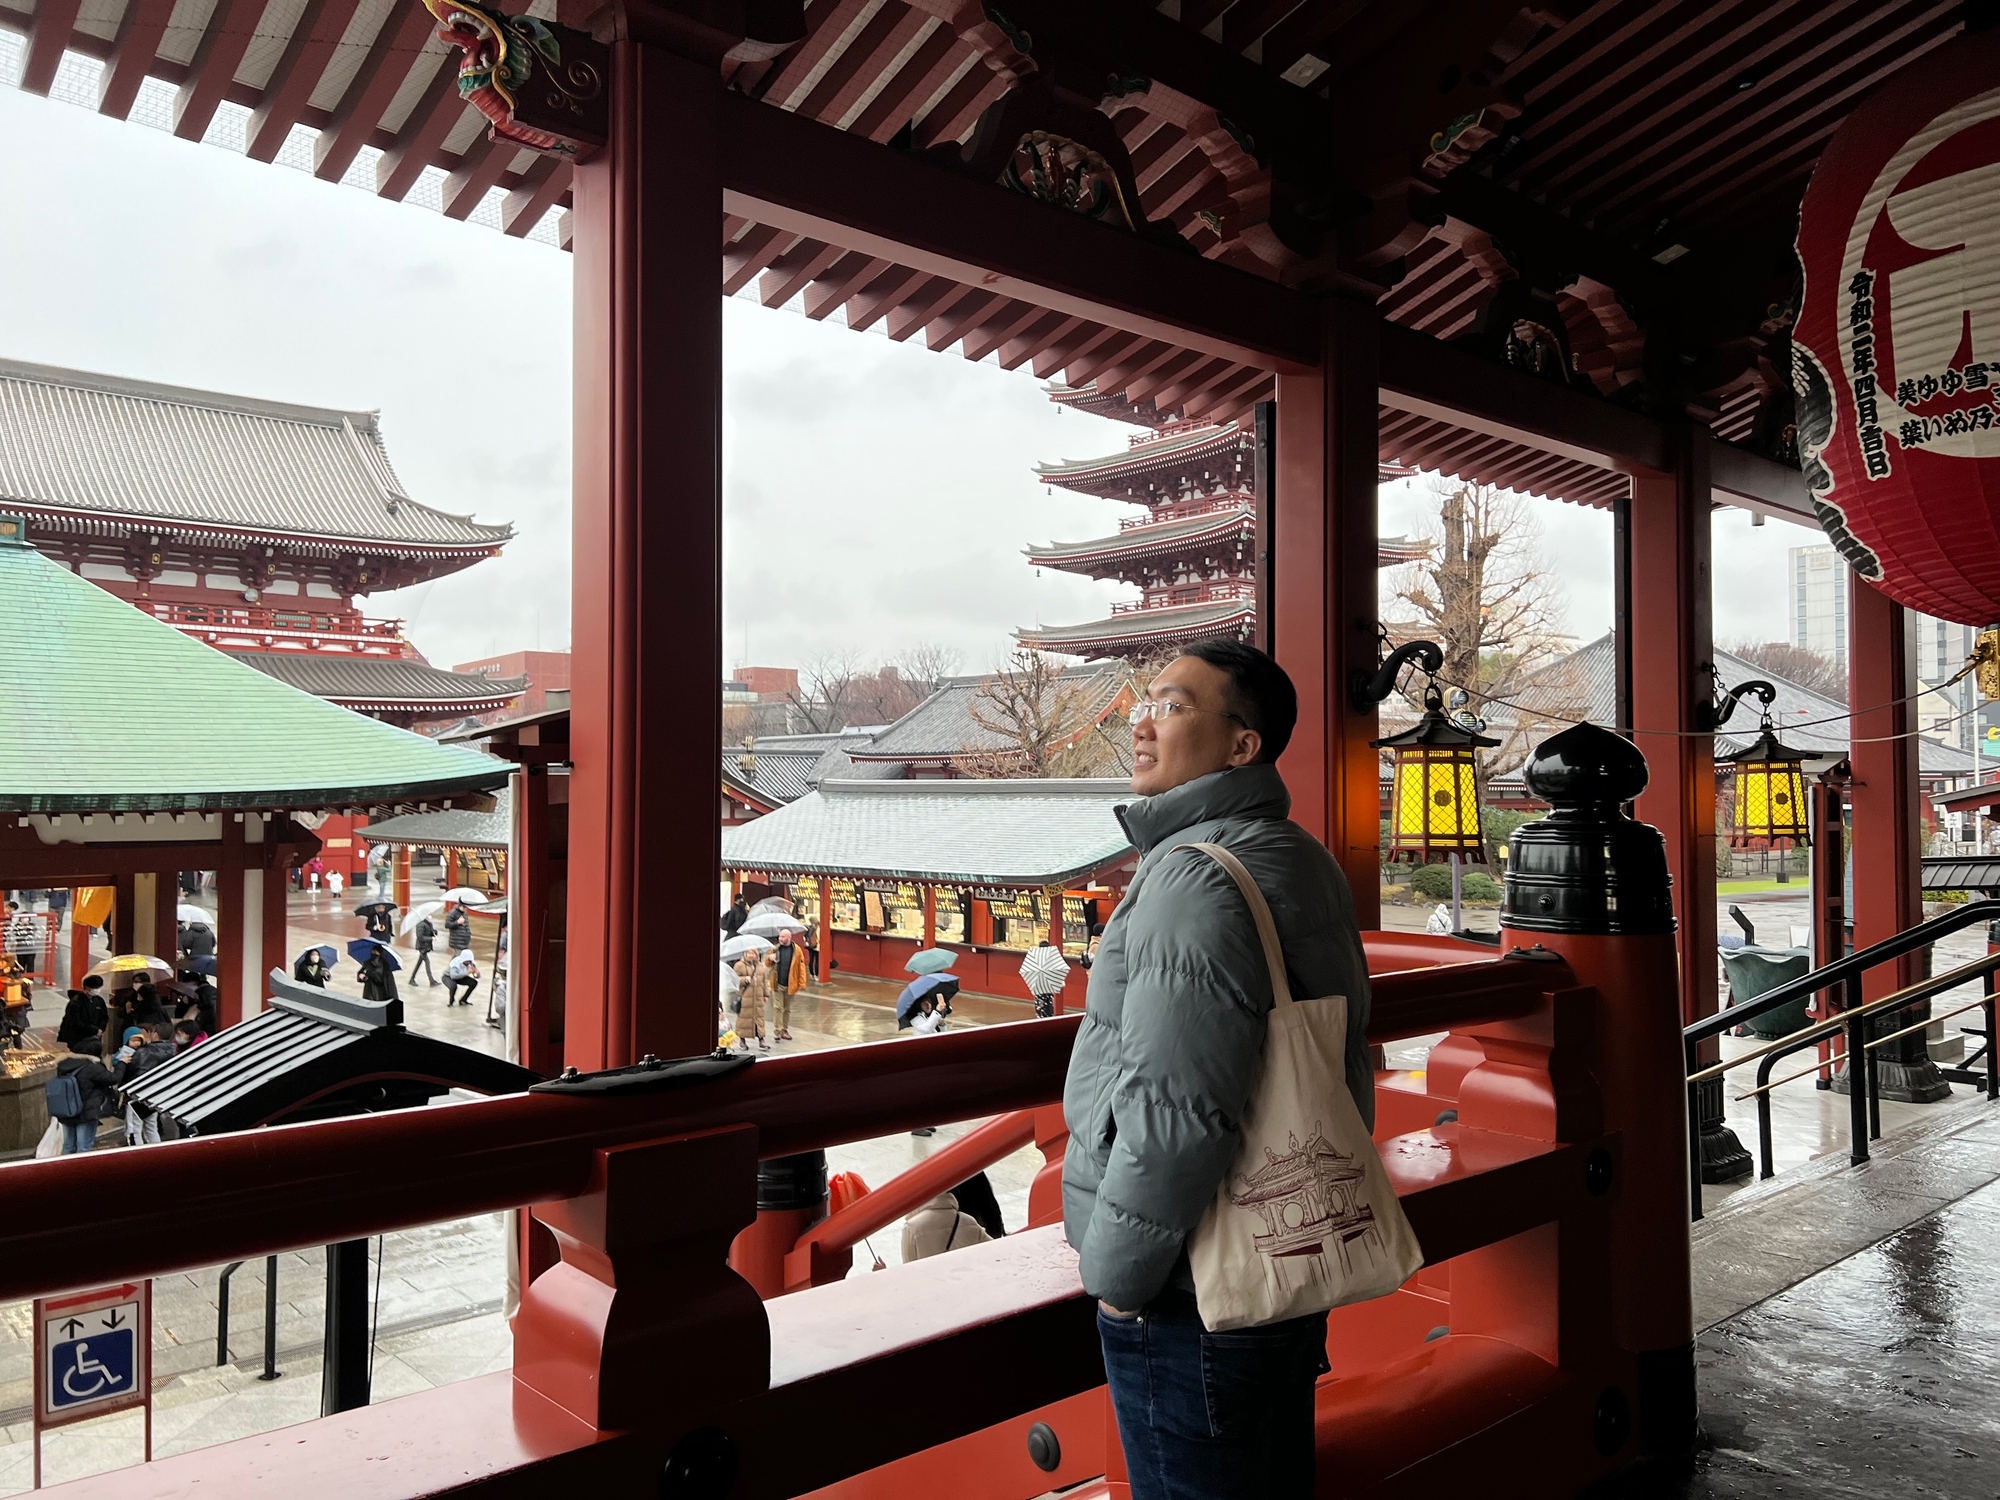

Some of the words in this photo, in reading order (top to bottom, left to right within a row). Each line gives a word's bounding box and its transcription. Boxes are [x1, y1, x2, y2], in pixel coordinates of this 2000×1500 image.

[1848, 271, 1890, 478] 令和二年四月吉日
